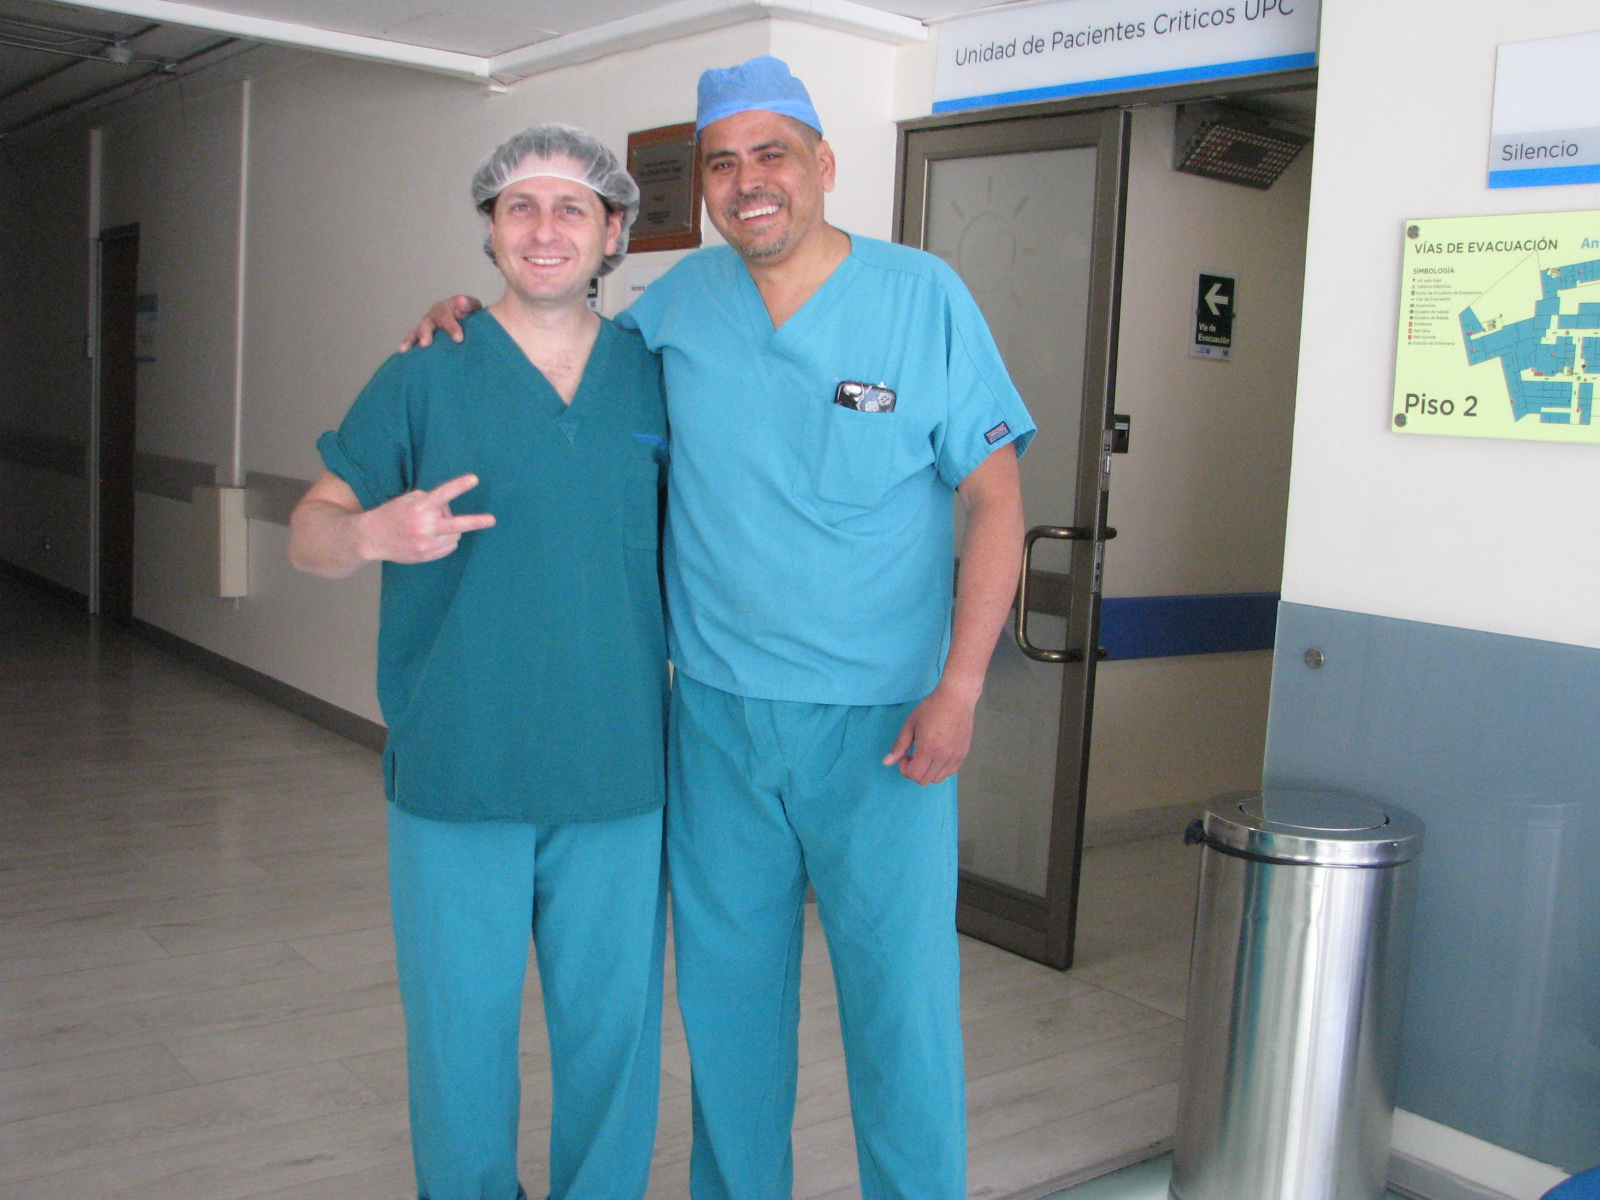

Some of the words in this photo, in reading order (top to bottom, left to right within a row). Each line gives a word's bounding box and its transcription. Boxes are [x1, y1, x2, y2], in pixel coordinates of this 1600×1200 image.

[955, 38, 1016, 66] Unidad
[1022, 35, 1045, 55] de
[1051, 20, 1146, 50] Pacientes
[1153, 8, 1235, 35] Criticos
[1244, 0, 1294, 21] UPC
[1501, 140, 1579, 162] Silencio
[1414, 241, 1443, 254] VÍAS
[1446, 242, 1464, 253] DE
[1467, 237, 1559, 253] EVACUACIÓN
[1405, 393, 1455, 416] Piso
[1463, 395, 1478, 417] 2
